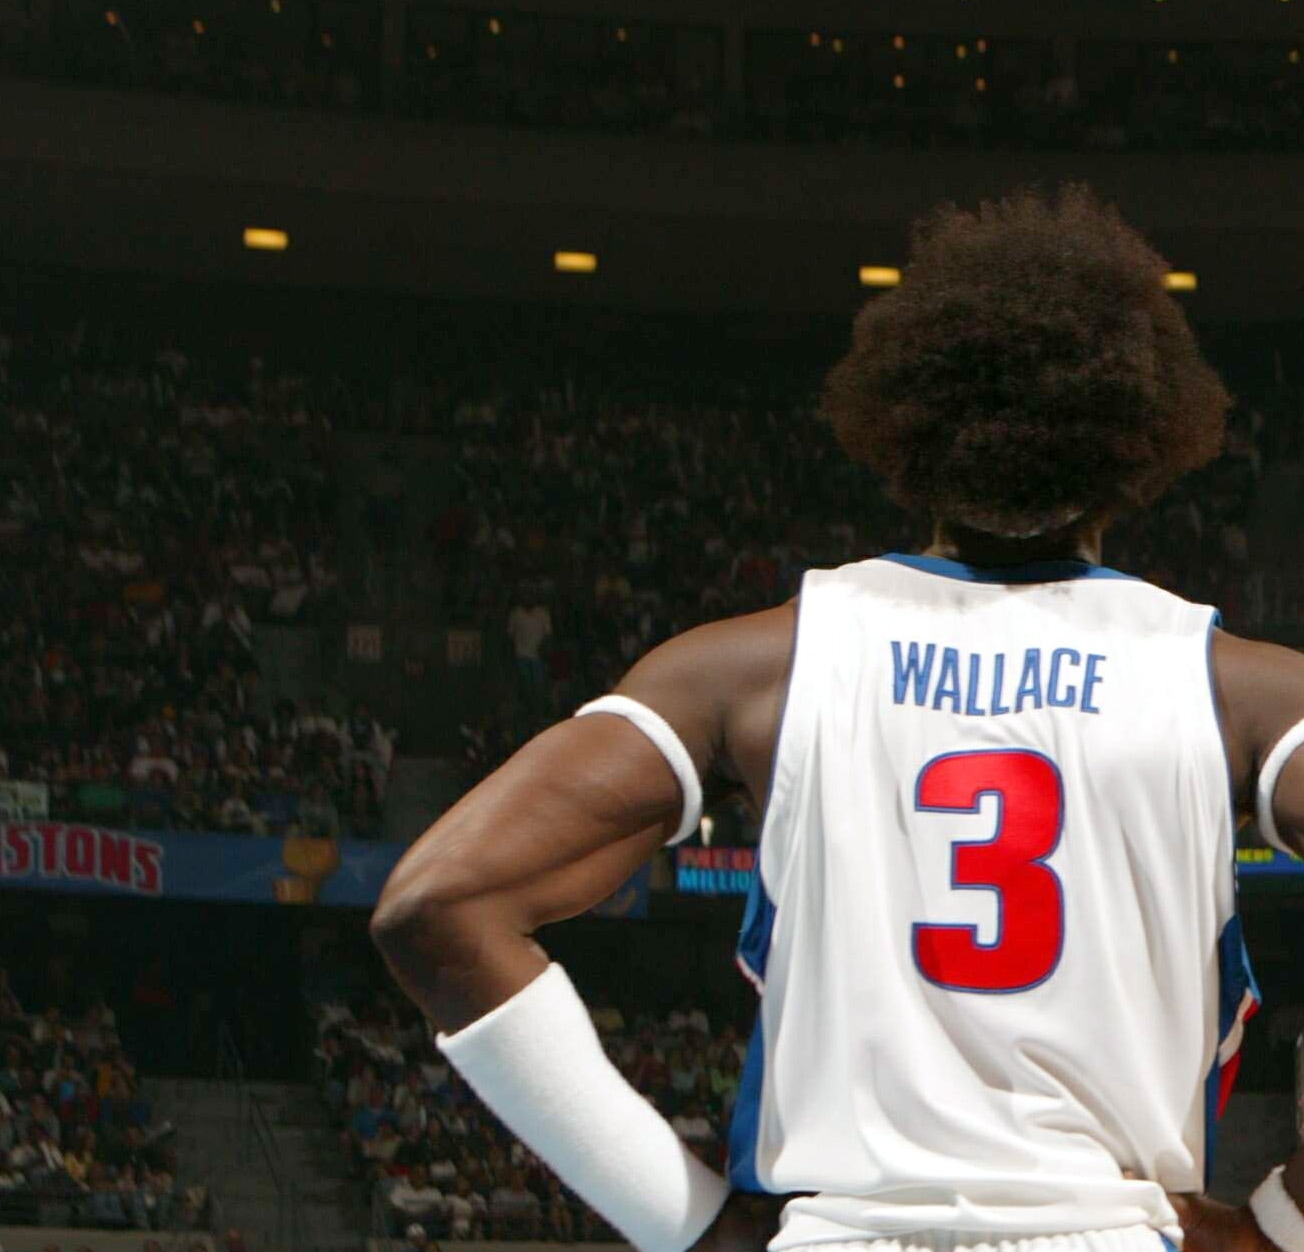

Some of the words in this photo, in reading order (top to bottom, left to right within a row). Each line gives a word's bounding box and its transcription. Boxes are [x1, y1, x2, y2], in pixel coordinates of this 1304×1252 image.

[890, 641, 1106, 716] WALLACE
[0, 821, 163, 896] STONS
[677, 868, 753, 891] MILLIO
[911, 748, 1065, 995] 3
